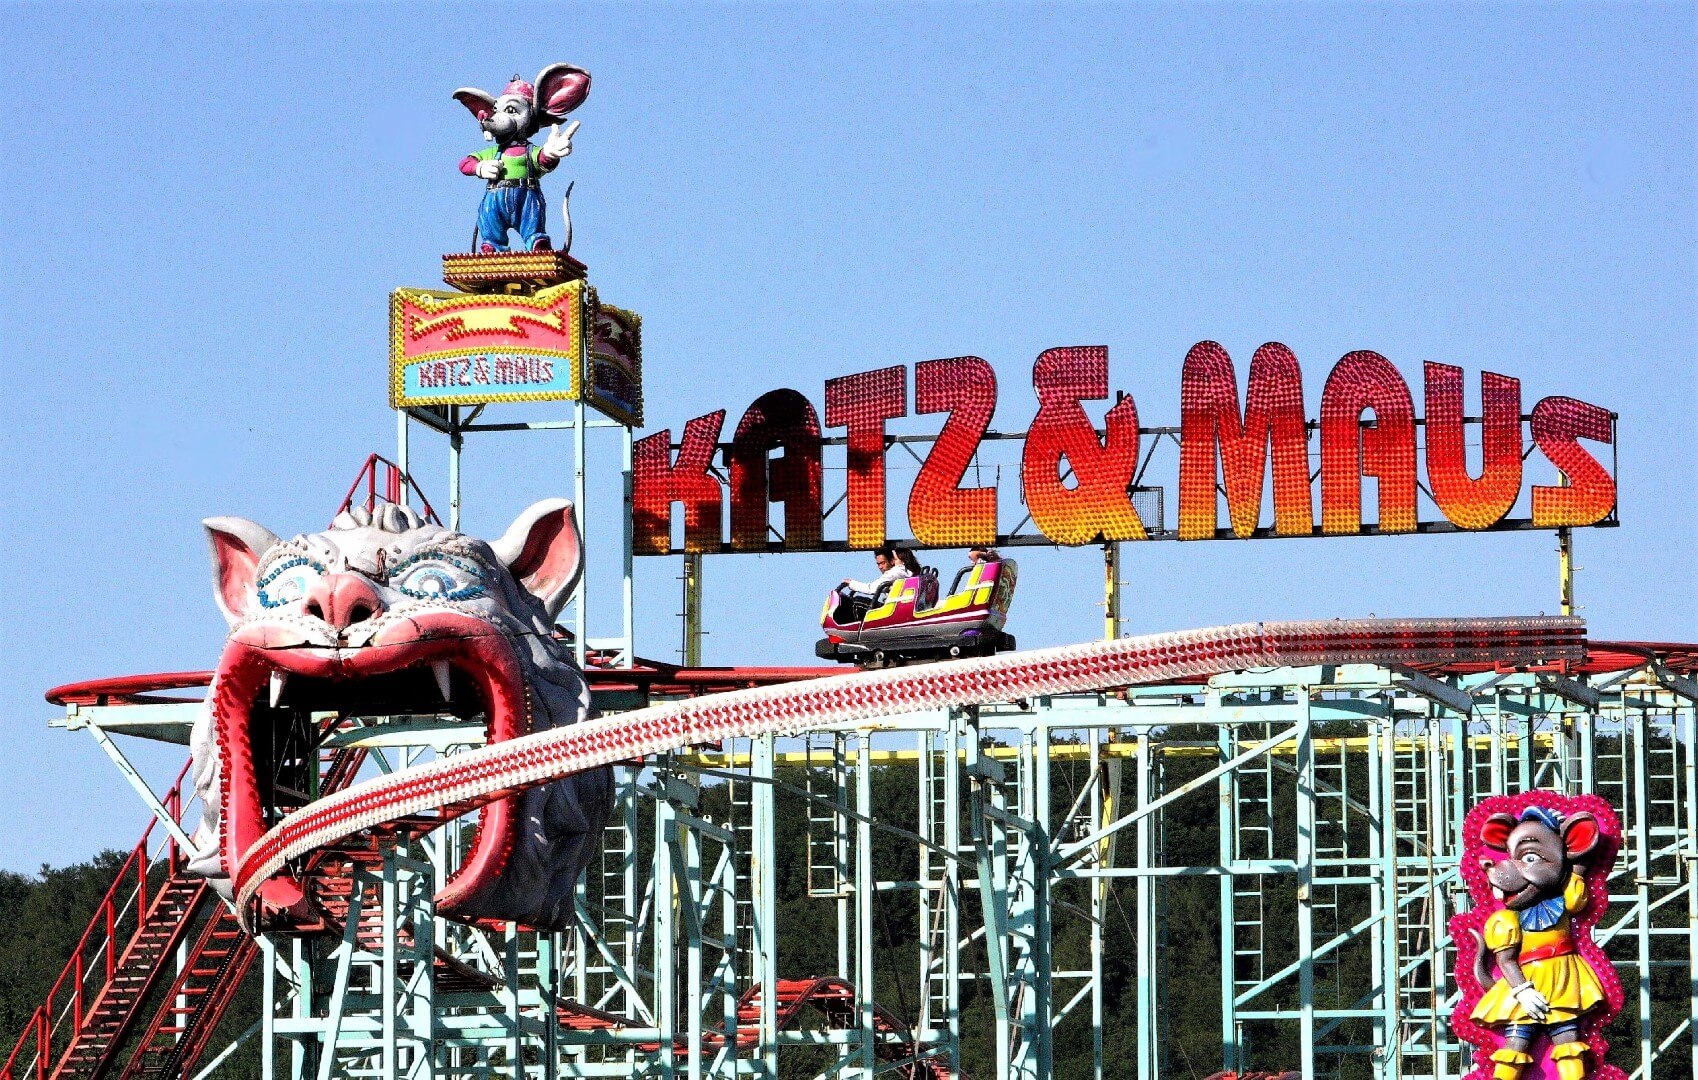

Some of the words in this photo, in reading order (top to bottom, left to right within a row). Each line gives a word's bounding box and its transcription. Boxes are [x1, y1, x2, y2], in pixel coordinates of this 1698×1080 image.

[418, 355, 472, 388] KATZ
[493, 354, 555, 386] MAUS
[632, 354, 999, 556] KATZ
[1021, 344, 1148, 547] &
[1177, 340, 1618, 541] MAUS
